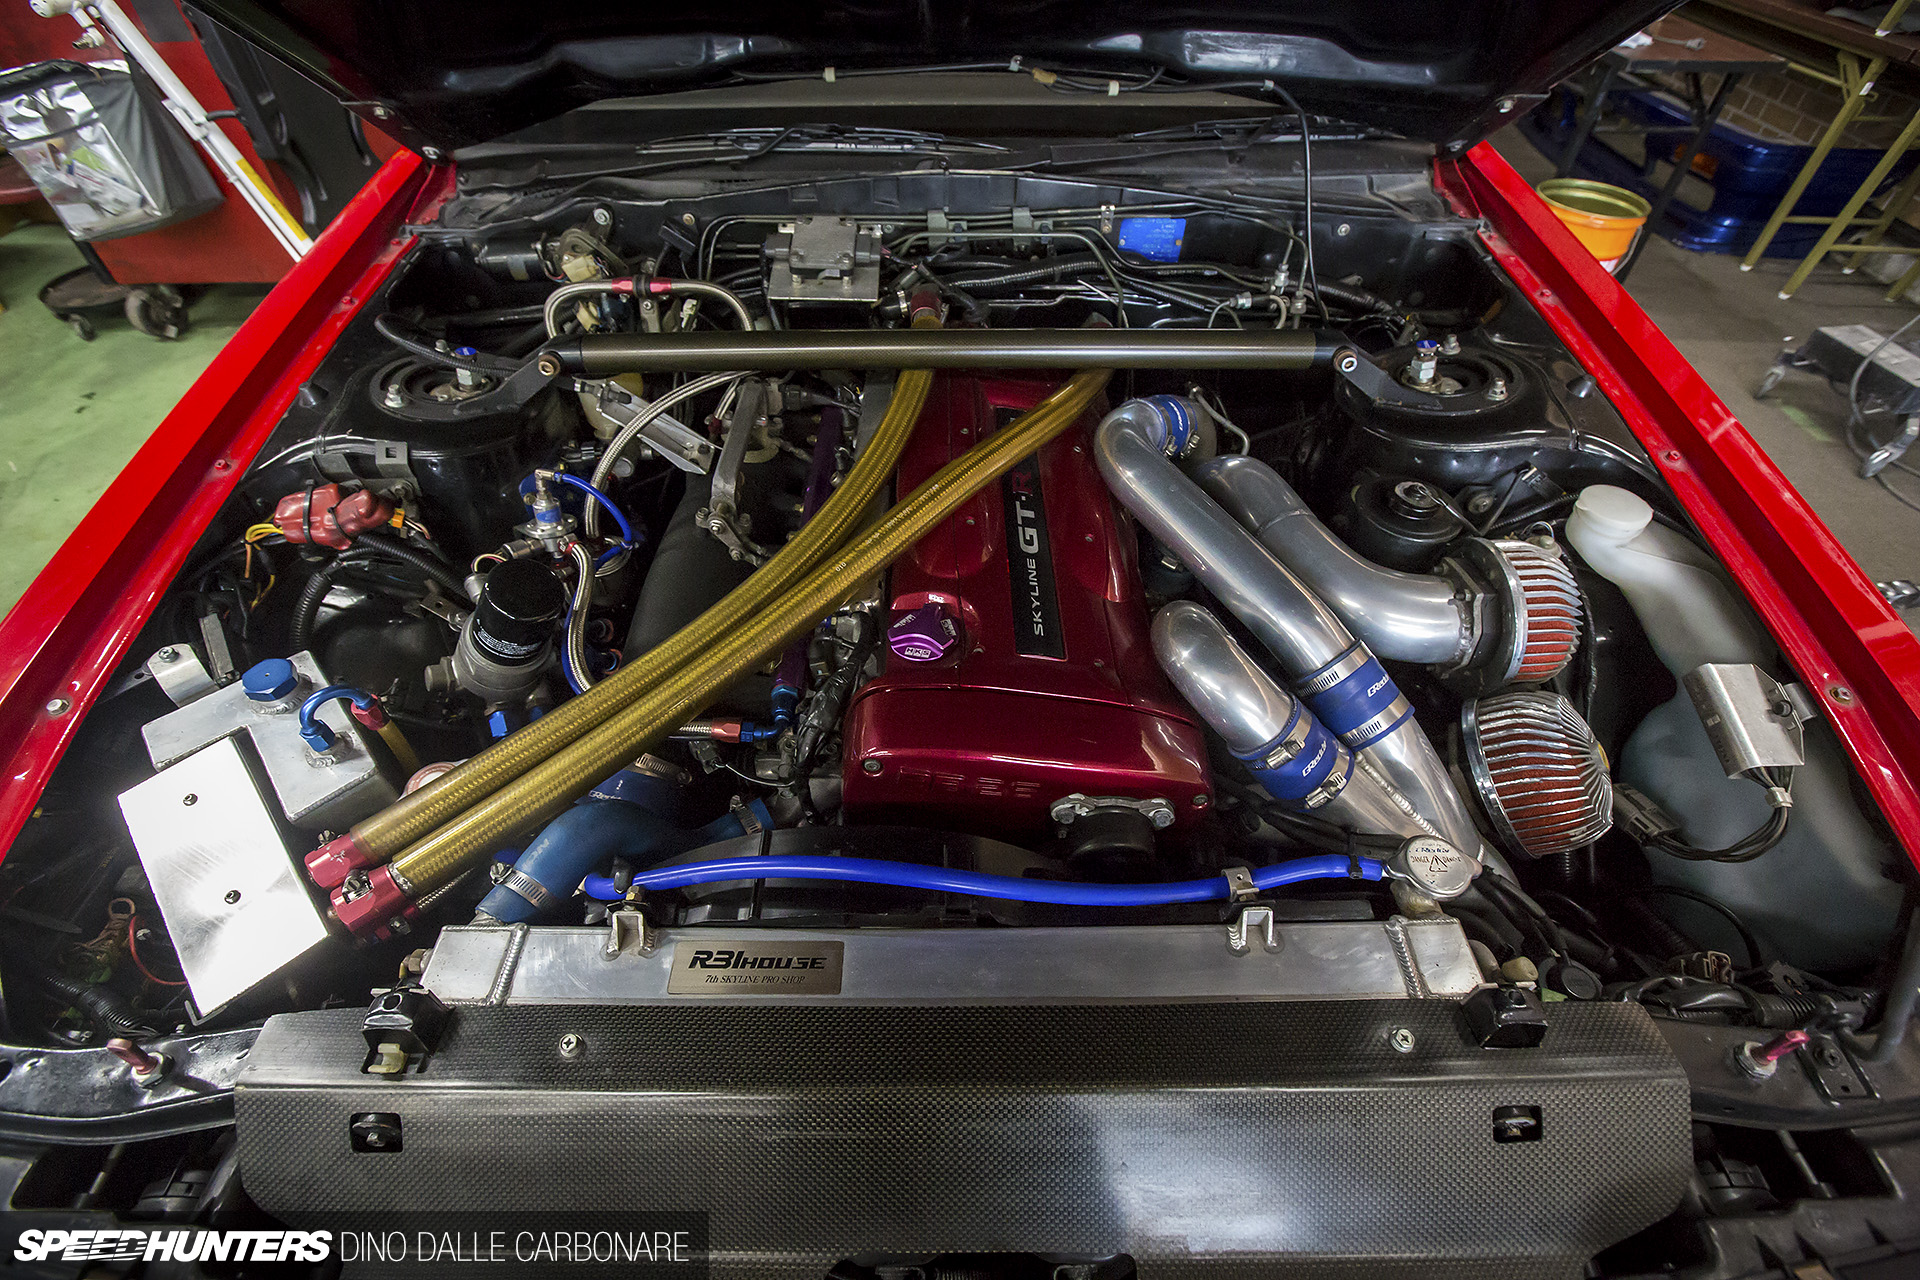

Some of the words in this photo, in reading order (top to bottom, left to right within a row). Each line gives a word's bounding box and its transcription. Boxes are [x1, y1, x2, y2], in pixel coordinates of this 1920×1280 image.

[1027, 558, 1044, 636] SKYLINE
[905, 646, 931, 659] HKS
[705, 974, 718, 984] 7th
[720, 975, 760, 984] SKYLINE
[761, 975, 780, 984] PRO
[781, 975, 805, 984] SHOP
